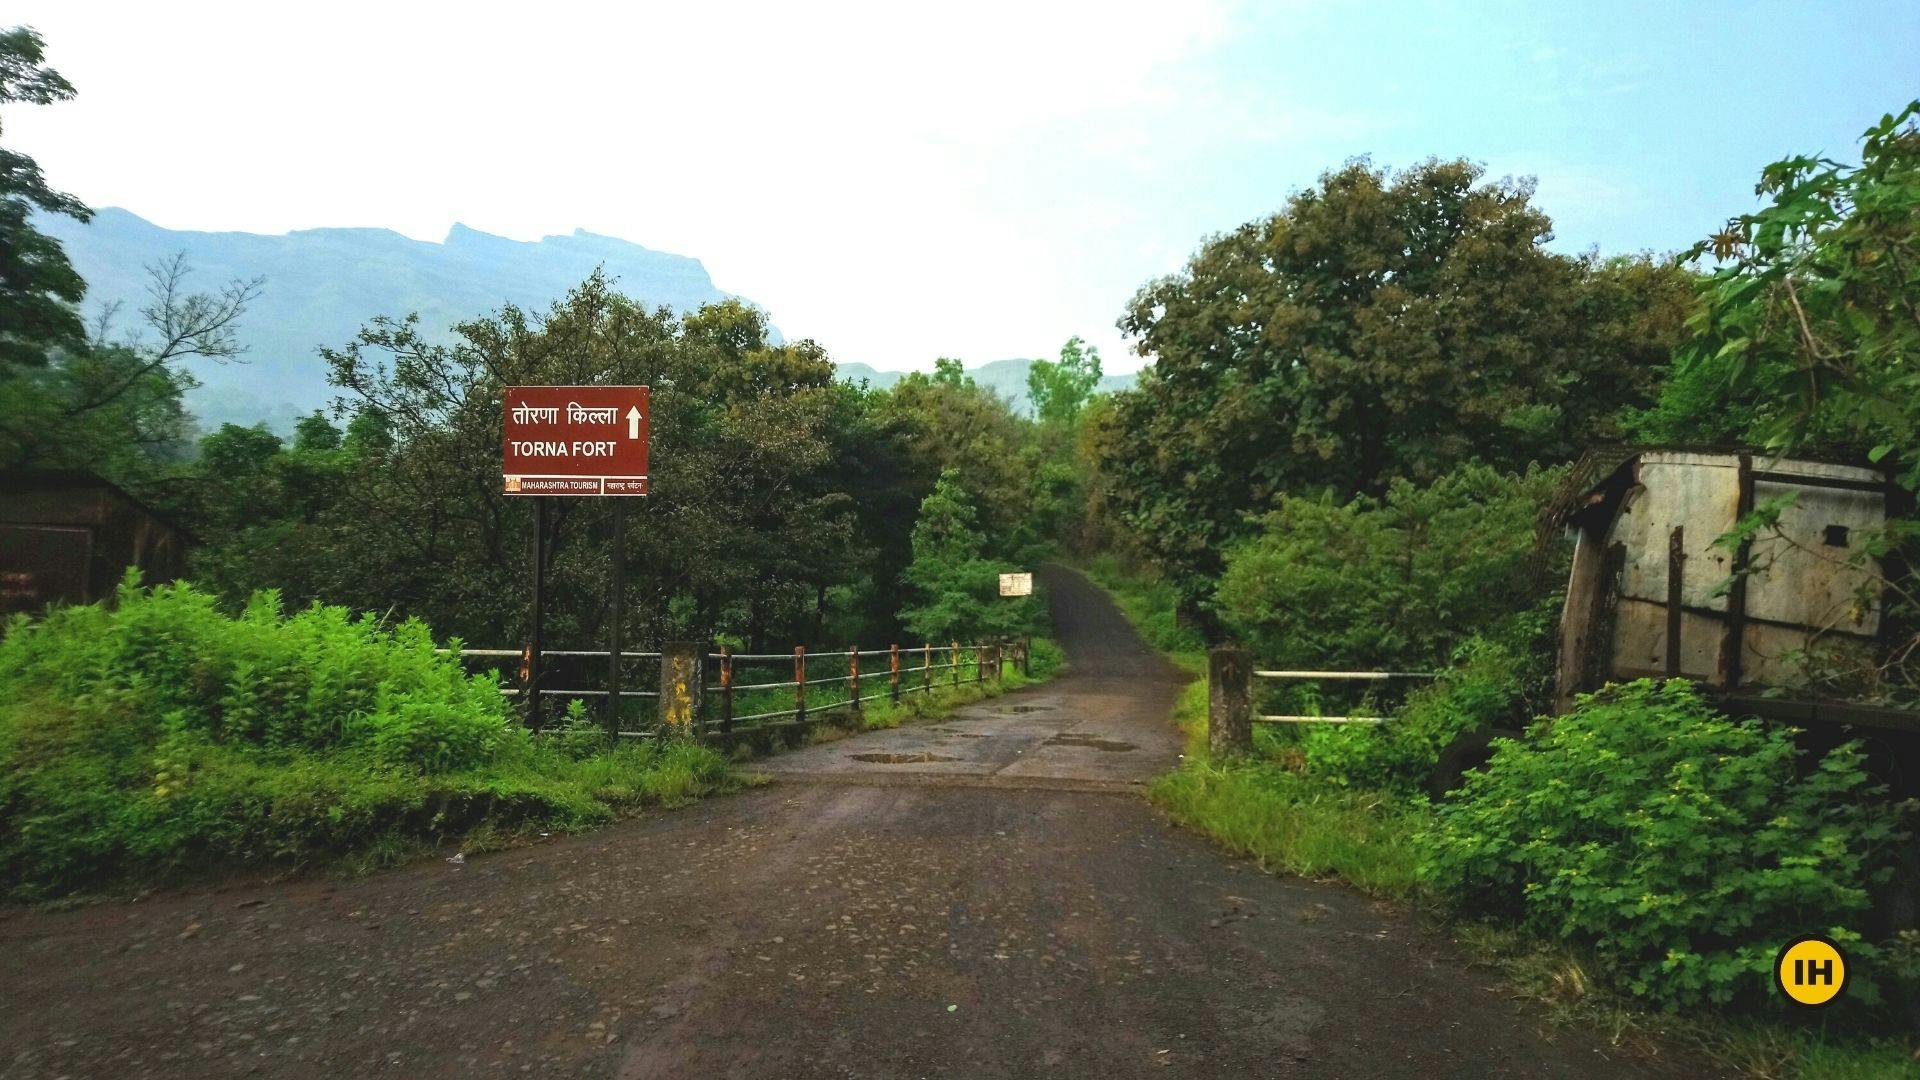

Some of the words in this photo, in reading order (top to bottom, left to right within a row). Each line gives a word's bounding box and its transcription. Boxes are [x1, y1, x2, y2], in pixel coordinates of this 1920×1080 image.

[512, 401, 559, 425] तोरणा
[566, 401, 618, 425] किल्ला
[511, 441, 568, 457] TORNA
[572, 442, 617, 457] FORT
[522, 481, 569, 490] MAHARASHTRA
[570, 481, 598, 490] TOURISM
